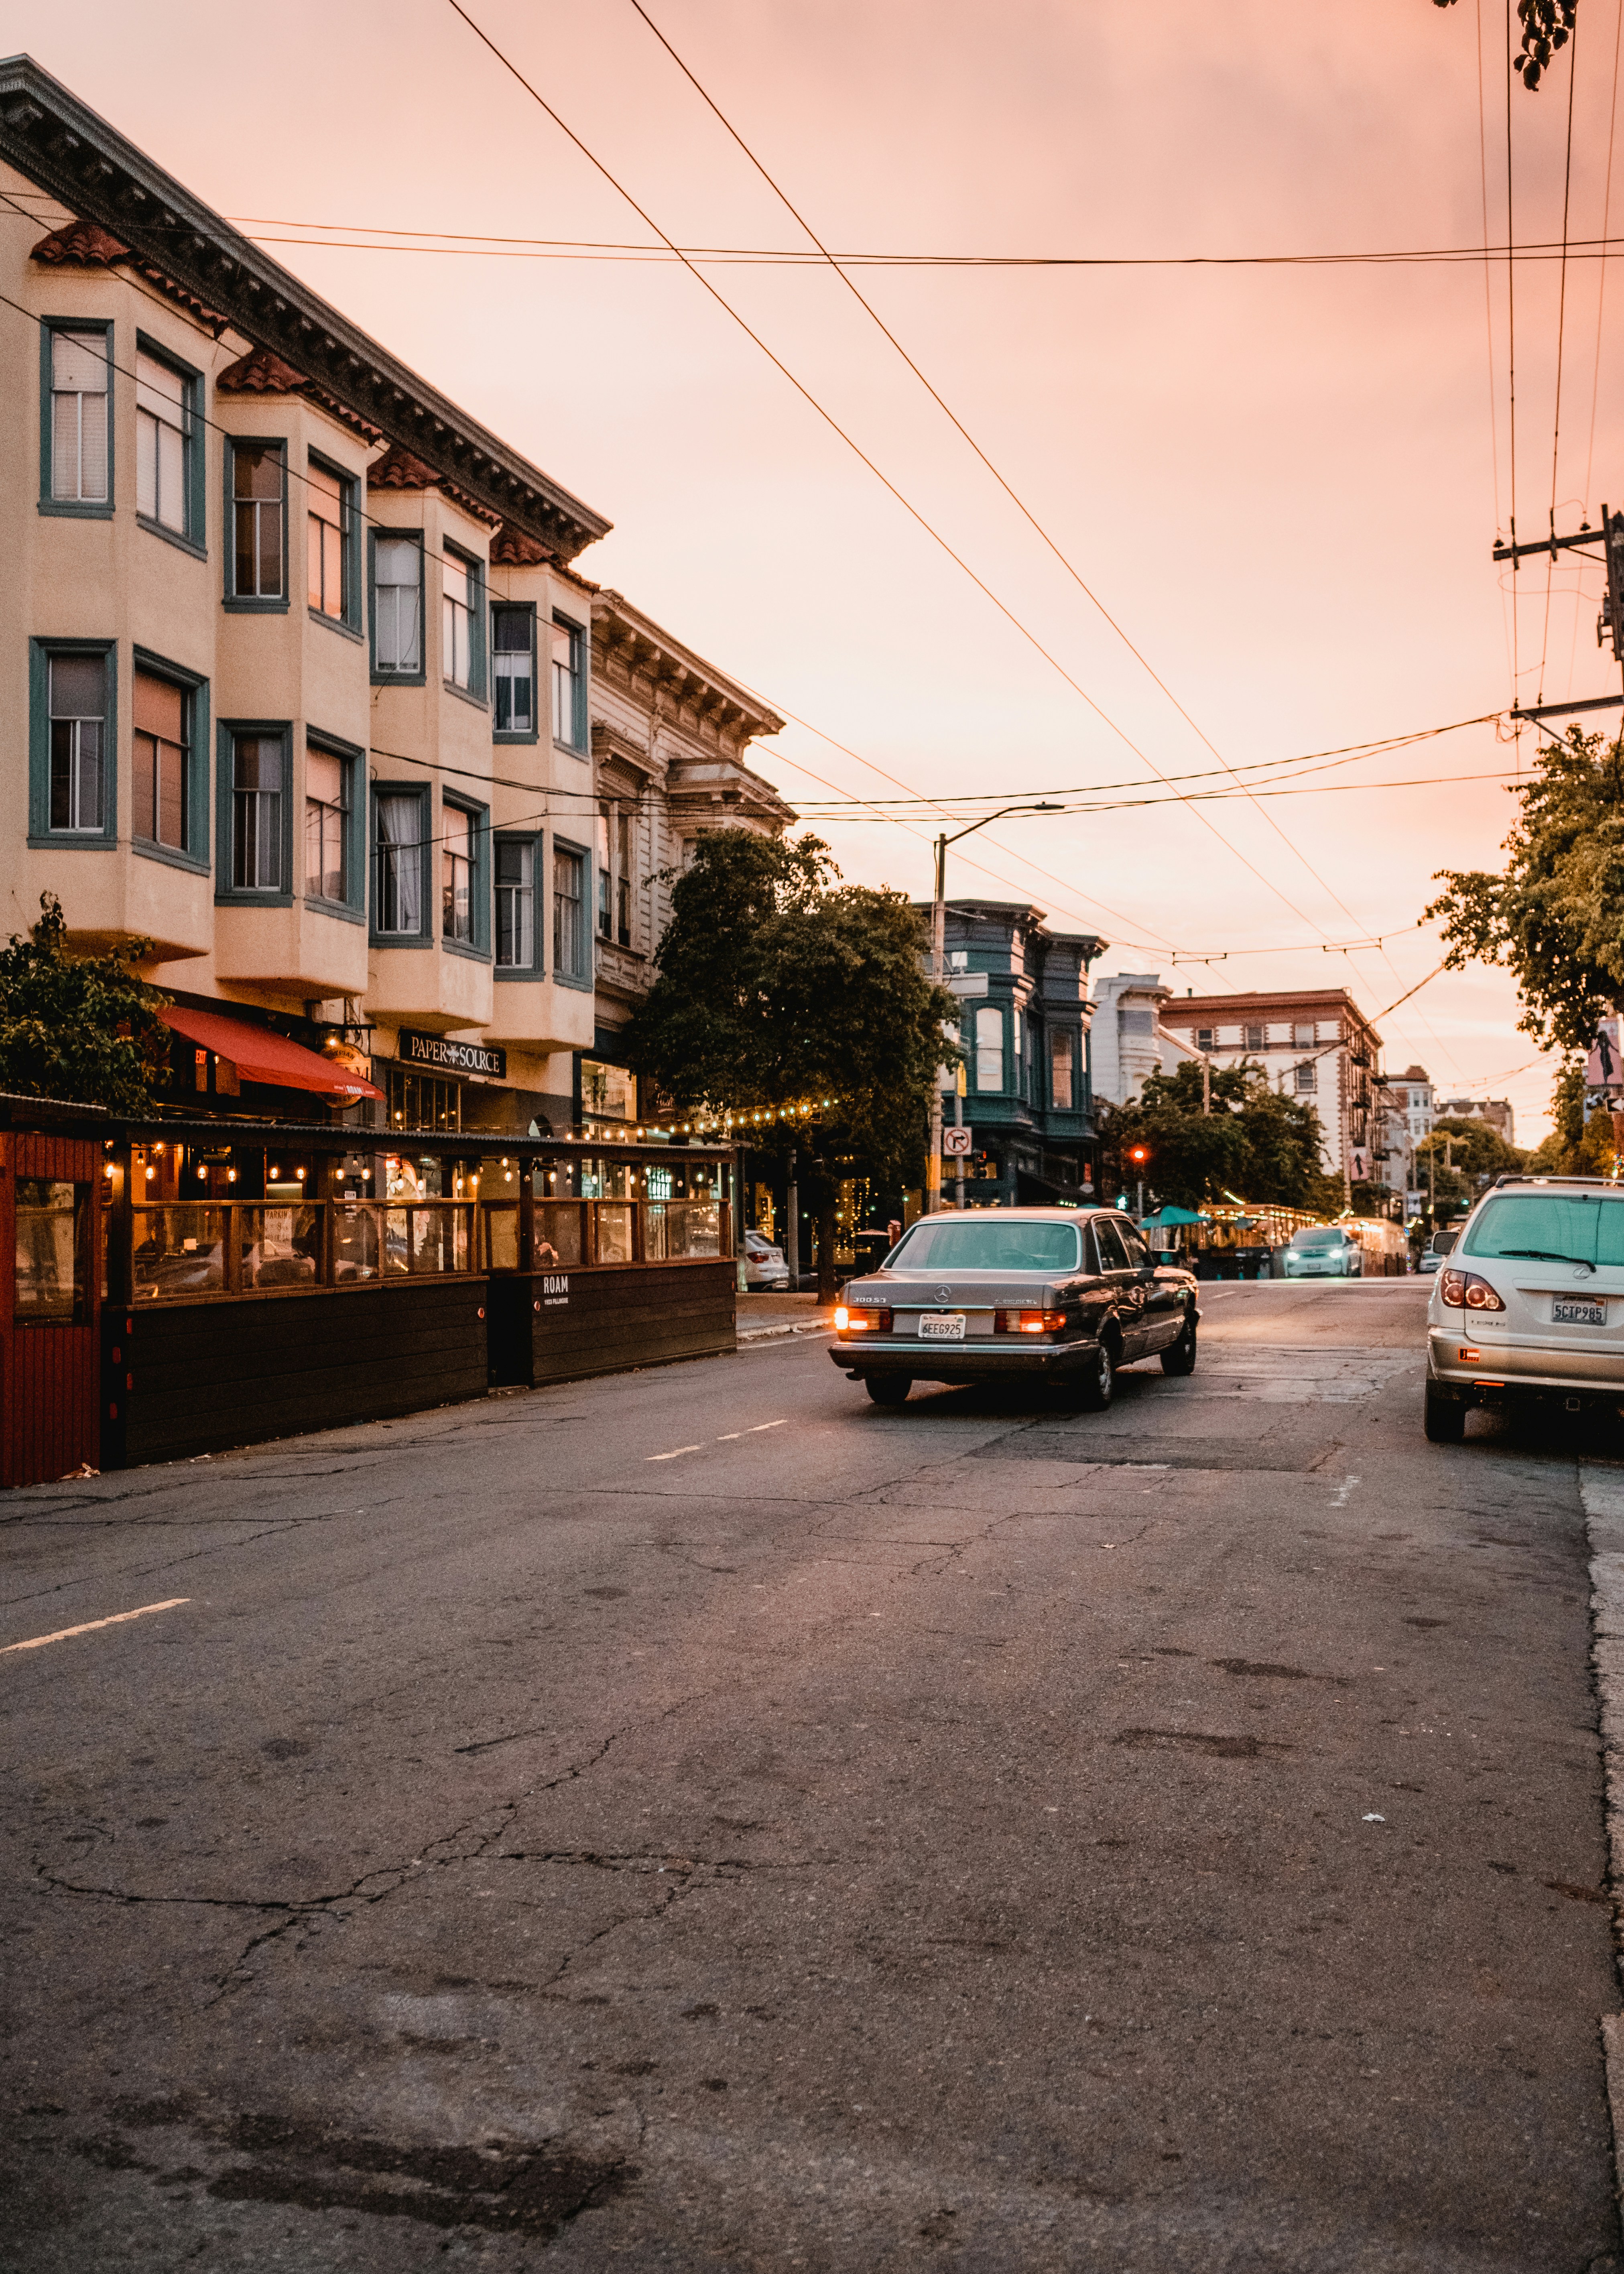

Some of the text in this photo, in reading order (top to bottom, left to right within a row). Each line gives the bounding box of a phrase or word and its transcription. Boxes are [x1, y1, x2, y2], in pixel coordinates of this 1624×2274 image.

[411, 1036, 500, 1072] PAPER SOURCE
[544, 1275, 568, 1293] ROAM
[1555, 1305, 1602, 1320] 5CIP985
[923, 1323, 961, 1334] 6EEG925
